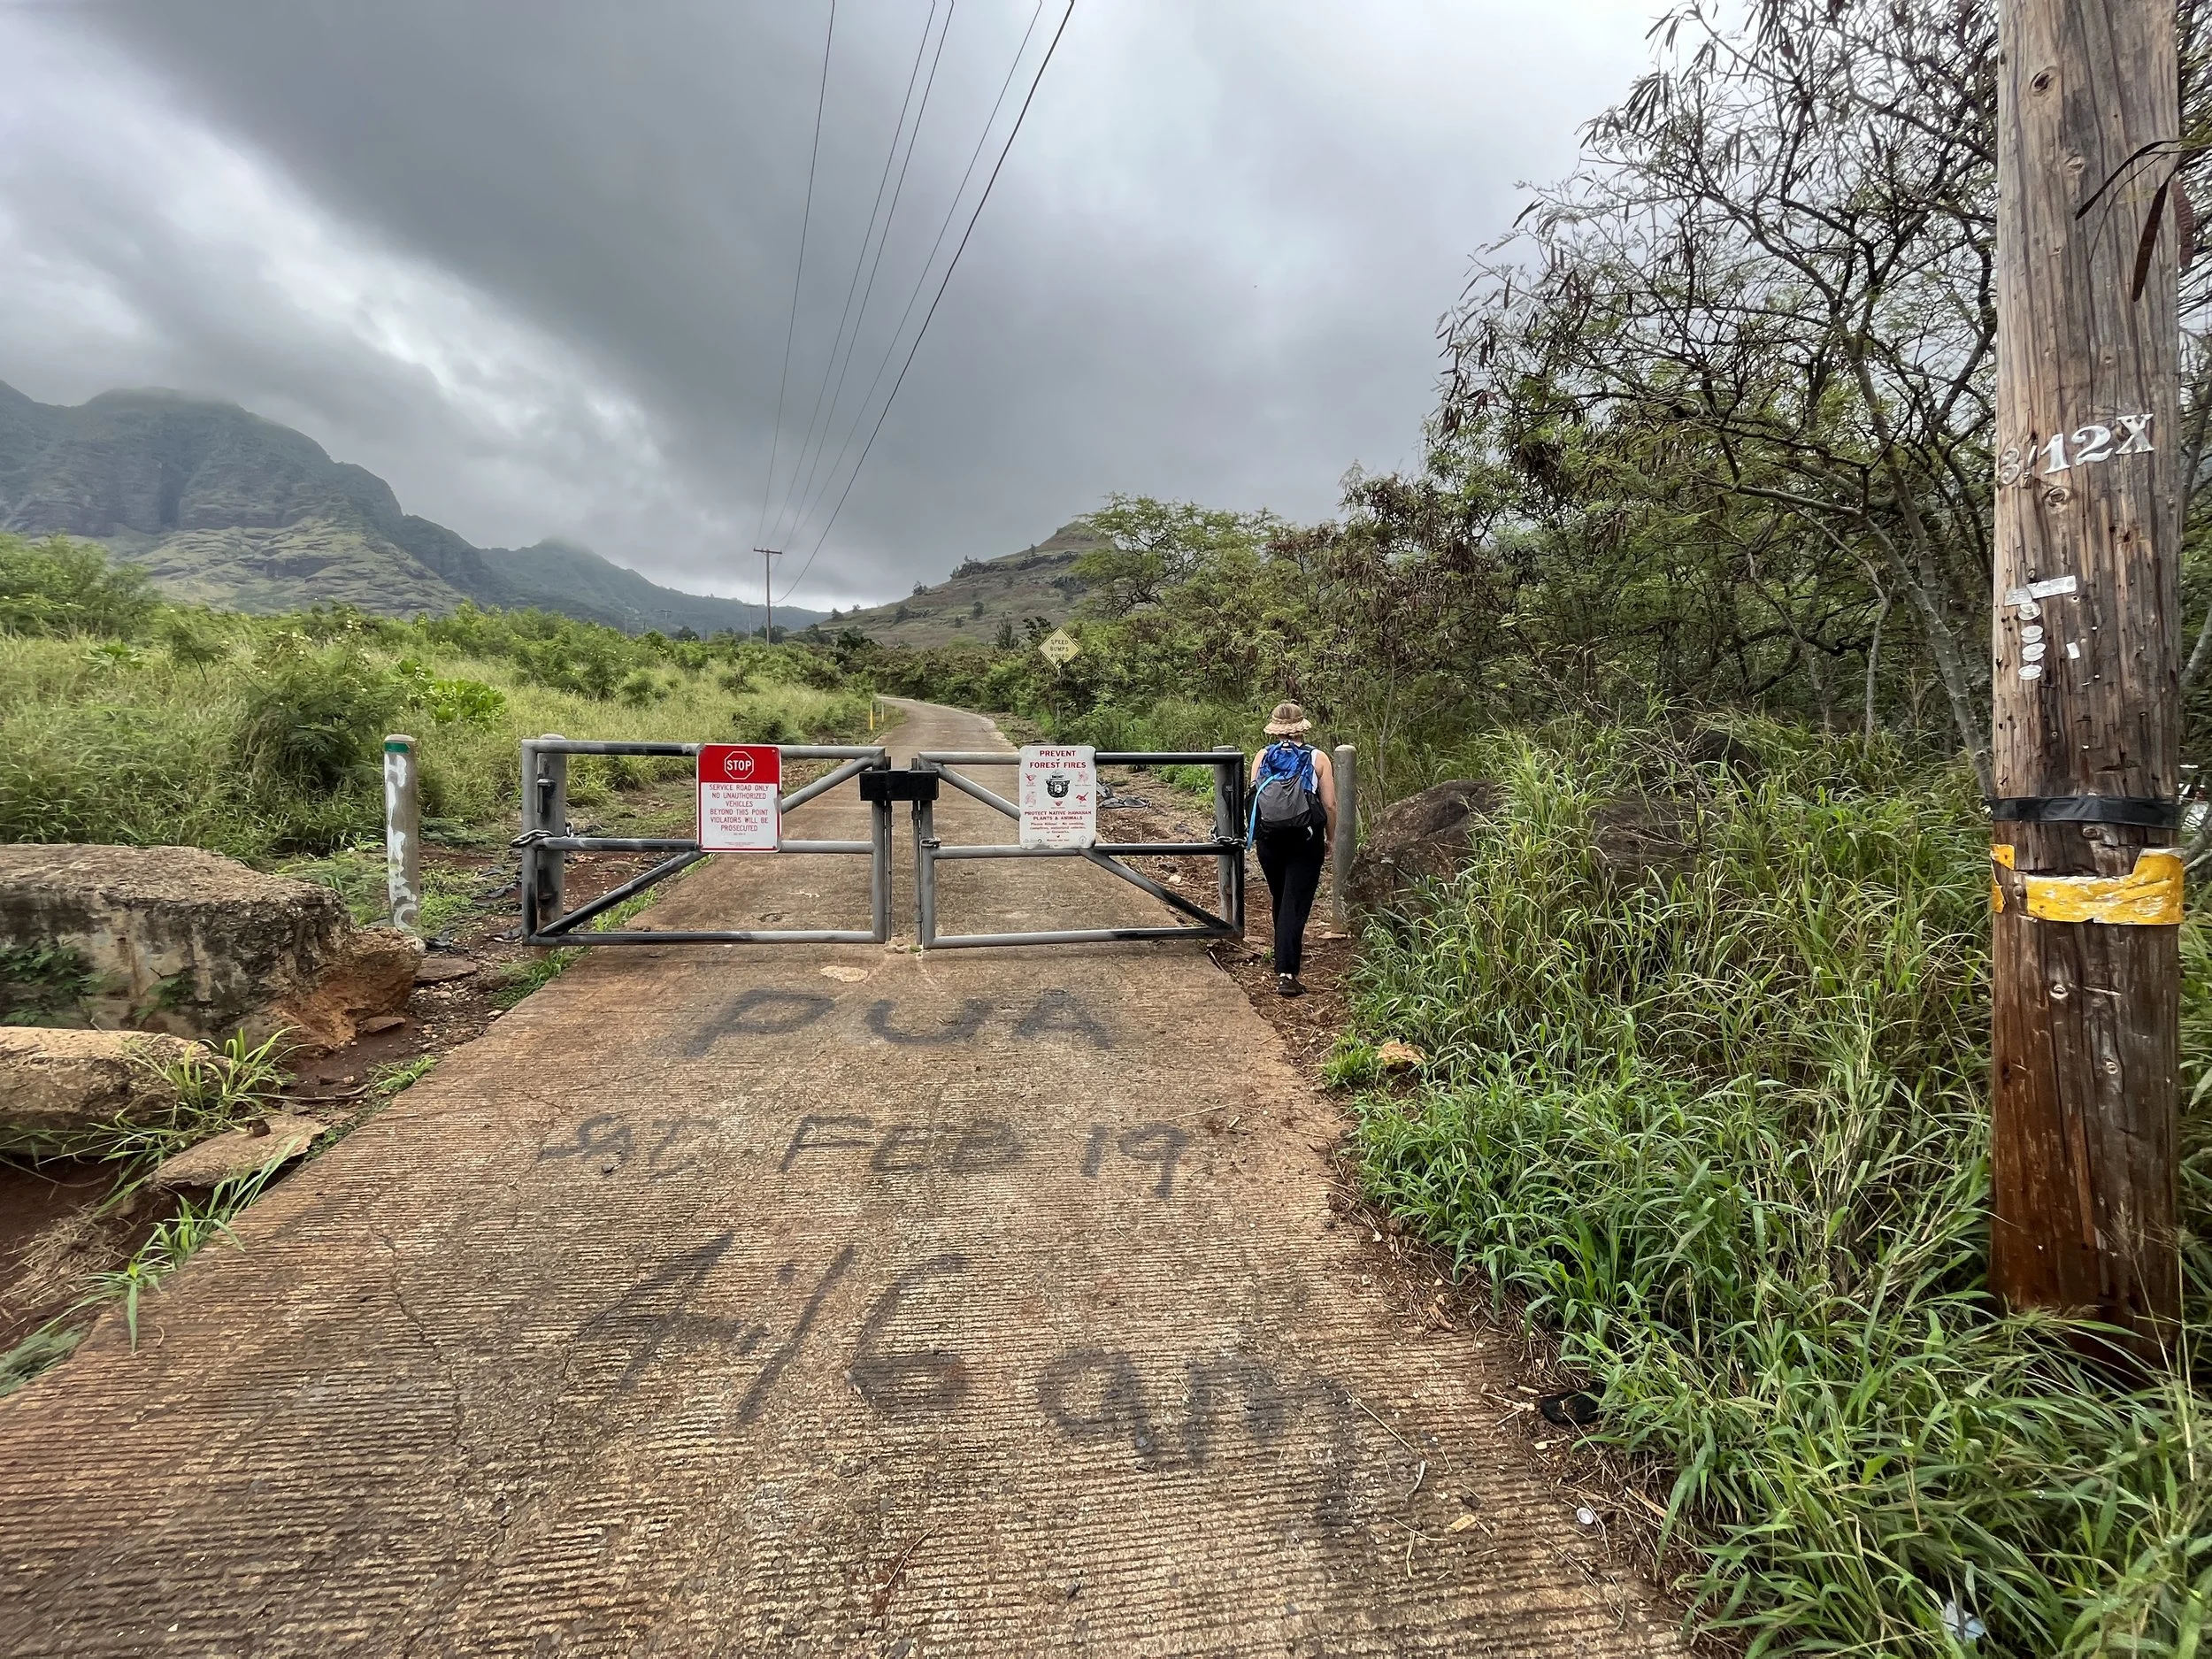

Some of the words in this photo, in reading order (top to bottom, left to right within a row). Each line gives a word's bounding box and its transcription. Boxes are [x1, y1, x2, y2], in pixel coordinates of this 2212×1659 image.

[726, 760, 752, 771] STOP
[680, 987, 1114, 1059] PUA
[778, 1113, 1027, 1176] FEB
[1078, 1120, 1192, 1199] 19
